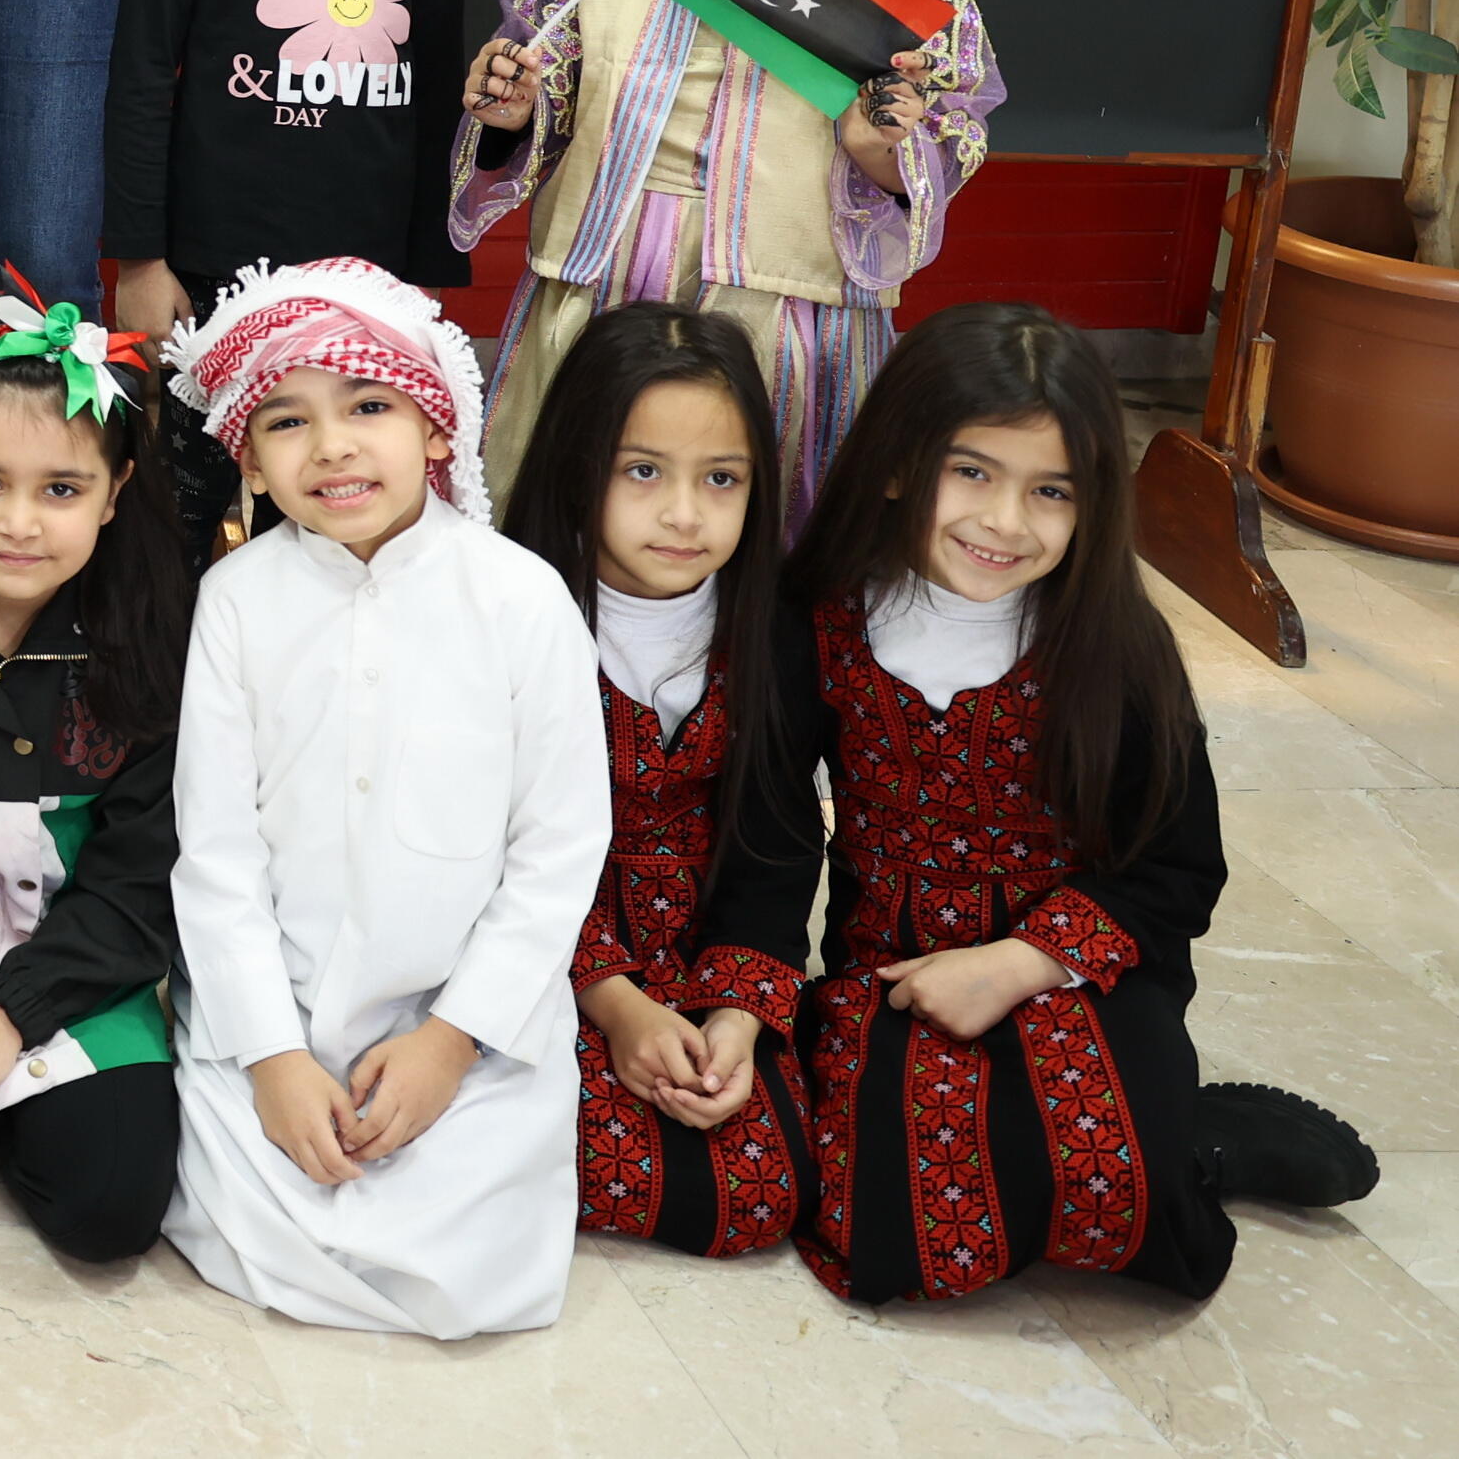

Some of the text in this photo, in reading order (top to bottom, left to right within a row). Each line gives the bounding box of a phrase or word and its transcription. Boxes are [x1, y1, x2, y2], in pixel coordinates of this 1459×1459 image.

[227, 53, 412, 107] & LOVELY
[273, 106, 328, 127] DAY
